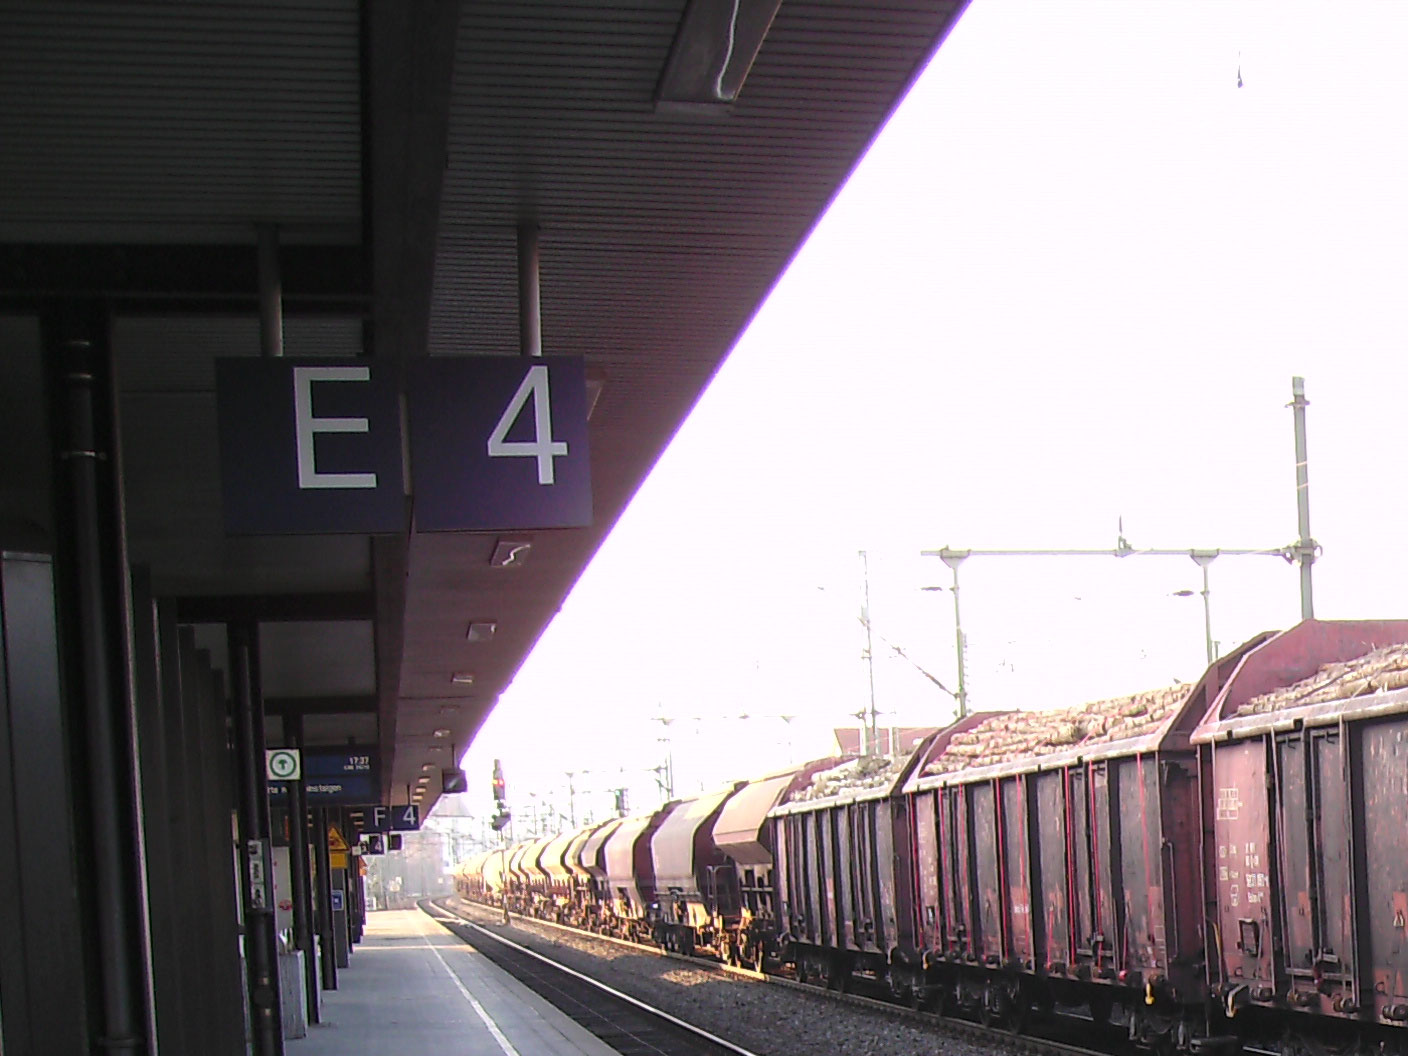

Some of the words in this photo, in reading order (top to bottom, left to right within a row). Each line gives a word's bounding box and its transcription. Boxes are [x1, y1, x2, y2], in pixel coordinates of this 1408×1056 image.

[293, 366, 377, 489] E
[487, 365, 568, 484] 4
[374, 807, 386, 827] F
[403, 806, 416, 826] 4
